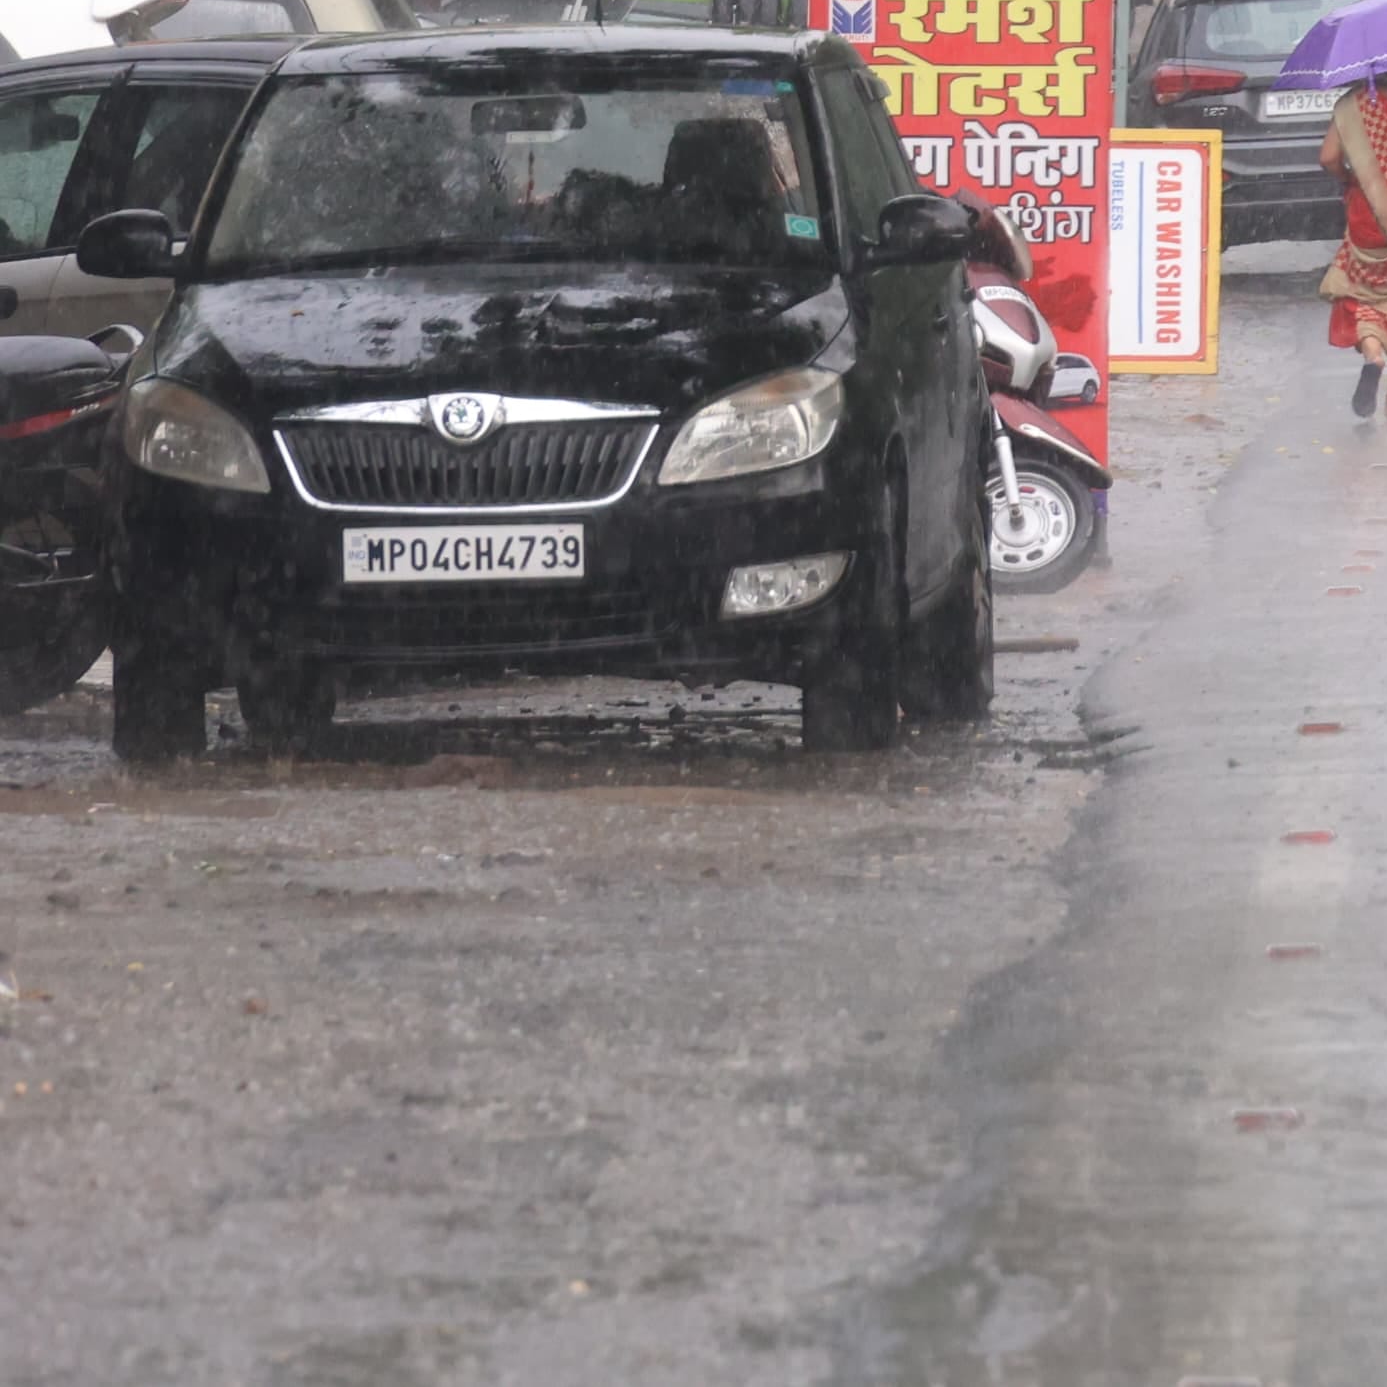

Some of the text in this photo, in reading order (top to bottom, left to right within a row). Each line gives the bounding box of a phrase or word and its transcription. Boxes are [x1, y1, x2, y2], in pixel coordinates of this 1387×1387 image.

[1277, 93, 1340, 111] MP37C6
[994, 190, 1094, 243] शिंग
[1111, 161, 1125, 231] TUBELESS
[1155, 161, 1182, 343] CAR WASHING
[367, 535, 581, 573] MP04CH4739
